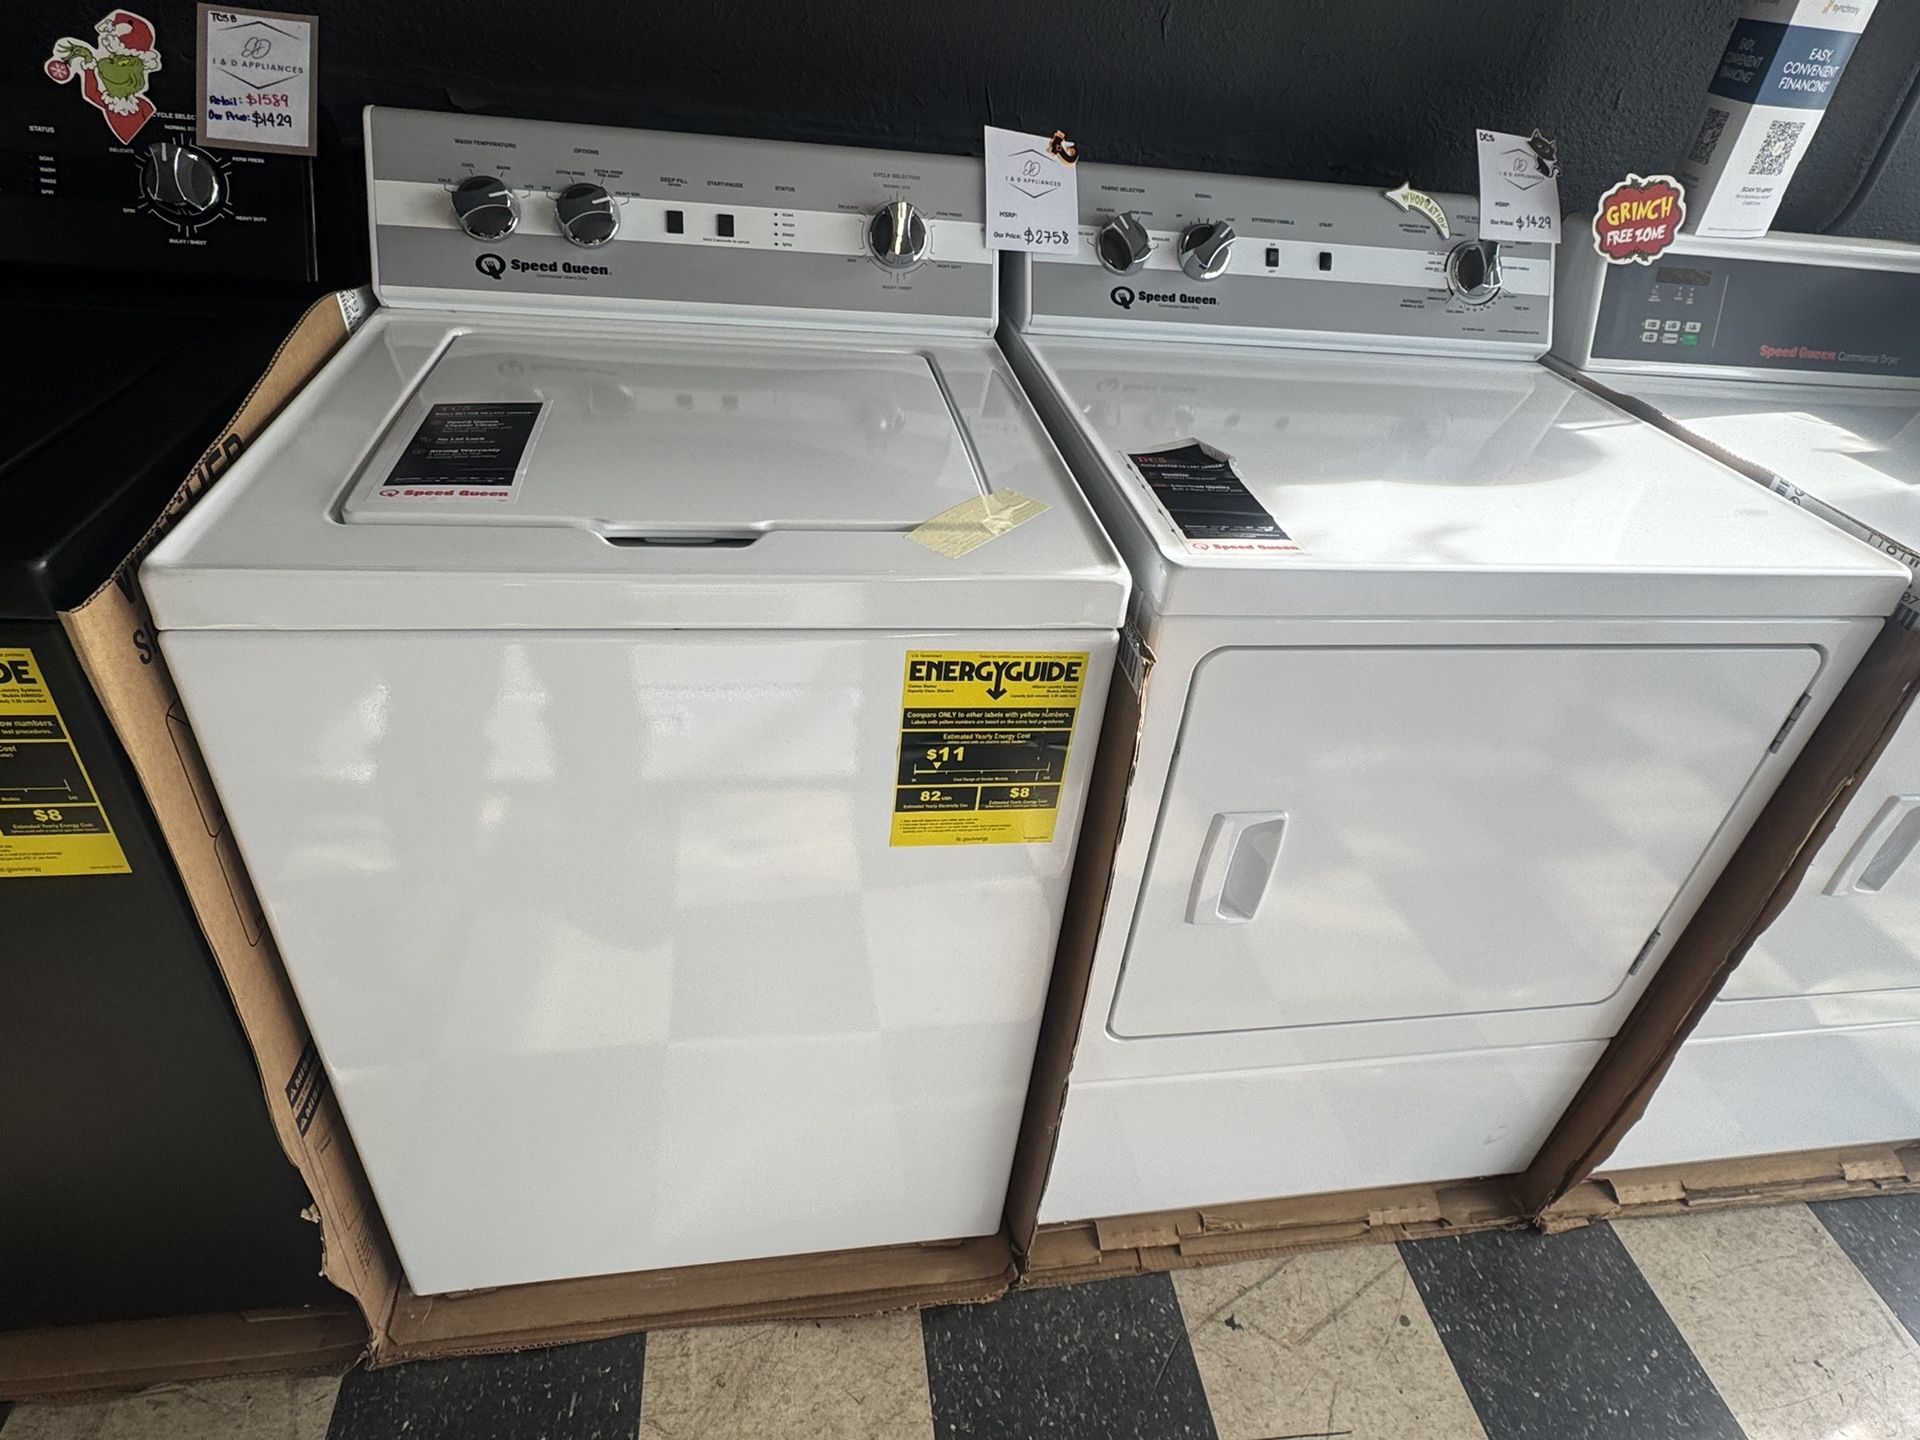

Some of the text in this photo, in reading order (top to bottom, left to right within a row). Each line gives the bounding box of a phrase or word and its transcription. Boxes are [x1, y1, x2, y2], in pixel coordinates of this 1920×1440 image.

[1809, 47, 1834, 64] EASY,
[241, 60, 304, 74] APPLIANCES
[1783, 61, 1840, 79] CONVENIENT
[246, 93, 289, 107] $1589
[252, 110, 292, 128] $1429
[29, 125, 55, 134] STATUS
[473, 139, 517, 149] TEMPERATURE
[573, 148, 600, 156] OPTIONS
[775, 185, 795, 193] STATUS
[1023, 178, 1062, 187] APPLIANCES
[999, 211, 1018, 219] MSRP:
[1606, 196, 1674, 226] GRINCH
[1516, 215, 1552, 232] $1429
[993, 226, 1070, 246] Our Price: $2758
[1606, 224, 1667, 246] FREE ZONE
[510, 258, 609, 276] Speed Queen
[1138, 290, 1217, 305] Speed Queen
[1759, 344, 1798, 359] Speed
[1799, 346, 1836, 360] Queen
[403, 488, 509, 498] Speed Queen
[1212, 543, 1254, 551] Speed
[908, 660, 1083, 685] ENERGYGUIDE
[906, 711, 937, 719] Compare
[1019, 711, 1041, 719] yellow
[14, 719, 55, 727] numbers.
[974, 733, 993, 741] Yearly
[994, 733, 1016, 741] Energy
[926, 746, 965, 761] $11
[920, 790, 941, 802] 82
[1009, 787, 1030, 799] $8
[33, 808, 63, 823] $8
